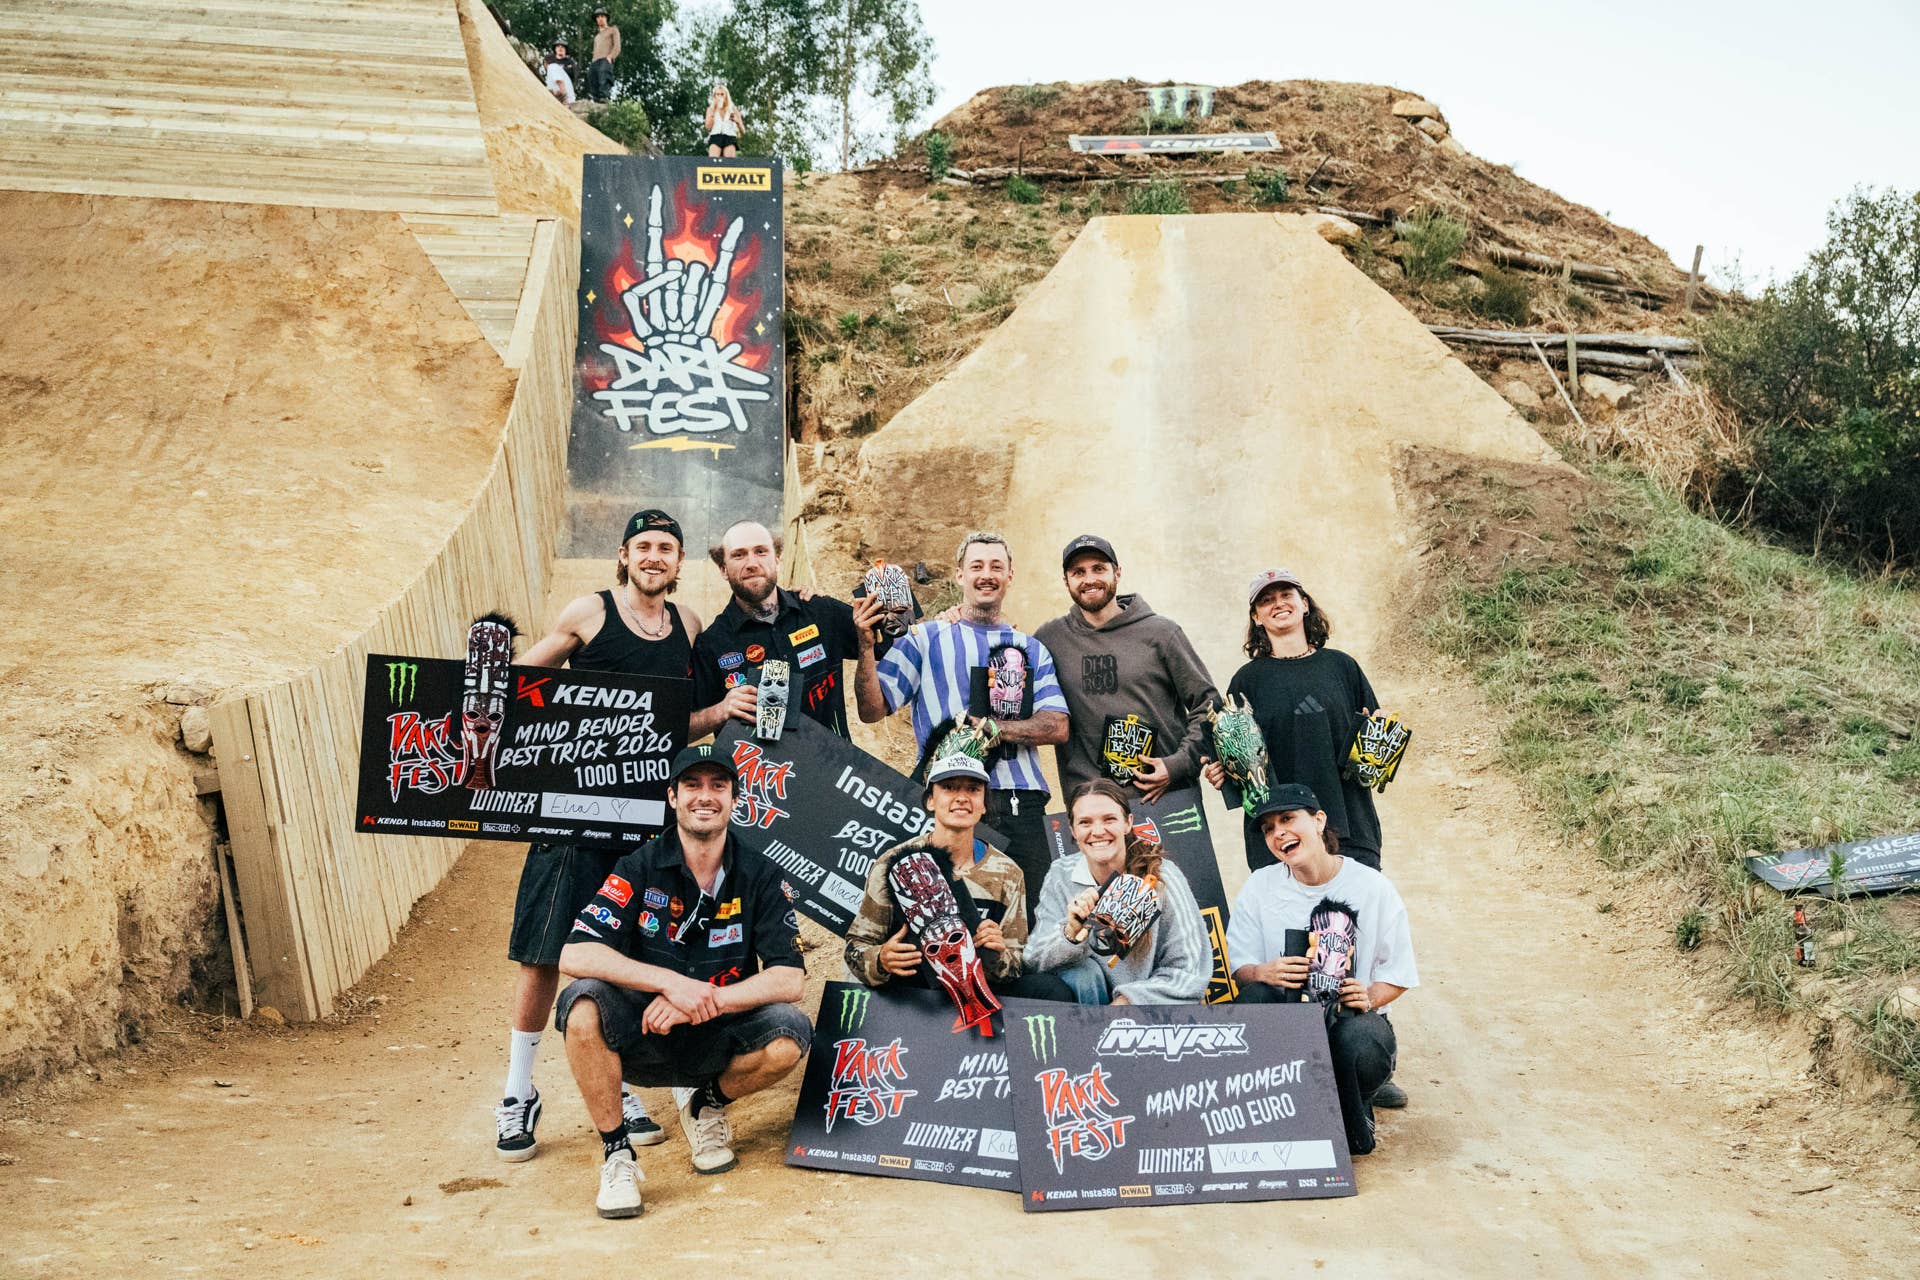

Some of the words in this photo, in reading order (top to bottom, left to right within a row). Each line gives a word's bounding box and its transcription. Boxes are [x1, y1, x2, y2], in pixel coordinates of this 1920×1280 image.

[1151, 138, 1252, 148] KENDA
[600, 337, 772, 391] DARK
[593, 387, 771, 434] FEST
[552, 684, 653, 711] KENDA
[515, 720, 572, 746] MIND
[576, 713, 655, 738] BENDER
[496, 742, 555, 770] BEST
[548, 737, 608, 764] TRICK
[613, 732, 673, 757] 2026
[1111, 740, 1141, 757] BEST
[1363, 740, 1396, 765] BEST
[574, 764, 618, 789] 1000
[622, 758, 671, 785] EURO
[1357, 763, 1384, 778] RUN
[470, 789, 539, 815] WINNER
[377, 817, 408, 826] KENDA
[411, 818, 446, 829] Insta360
[831, 819, 897, 855] BEST
[1852, 836, 1920, 855] QUEE
[762, 839, 827, 887] WINNER
[1867, 845, 1920, 860] DARKNE
[1855, 862, 1905, 874] WINNER
[644, 890, 668, 907] STINKY
[935, 1077, 993, 1103] BEST
[1146, 1079, 1219, 1119] MAVRIX
[1225, 1059, 1308, 1098] MOMENT
[824, 1086, 919, 1135] FEST
[1200, 1107, 1245, 1138] 1000
[1250, 1093, 1297, 1127] EURO
[903, 1122, 978, 1152] WINNER
[988, 1133, 1017, 1154] Rob
[1047, 1115, 1136, 1175] FEST
[807, 1148, 839, 1159] KENDA
[841, 1151, 877, 1163] Insta360
[1138, 1147, 1206, 1175] WINNER
[1046, 1190, 1078, 1200] KENDA
[1081, 1187, 1117, 1199] Insta360
